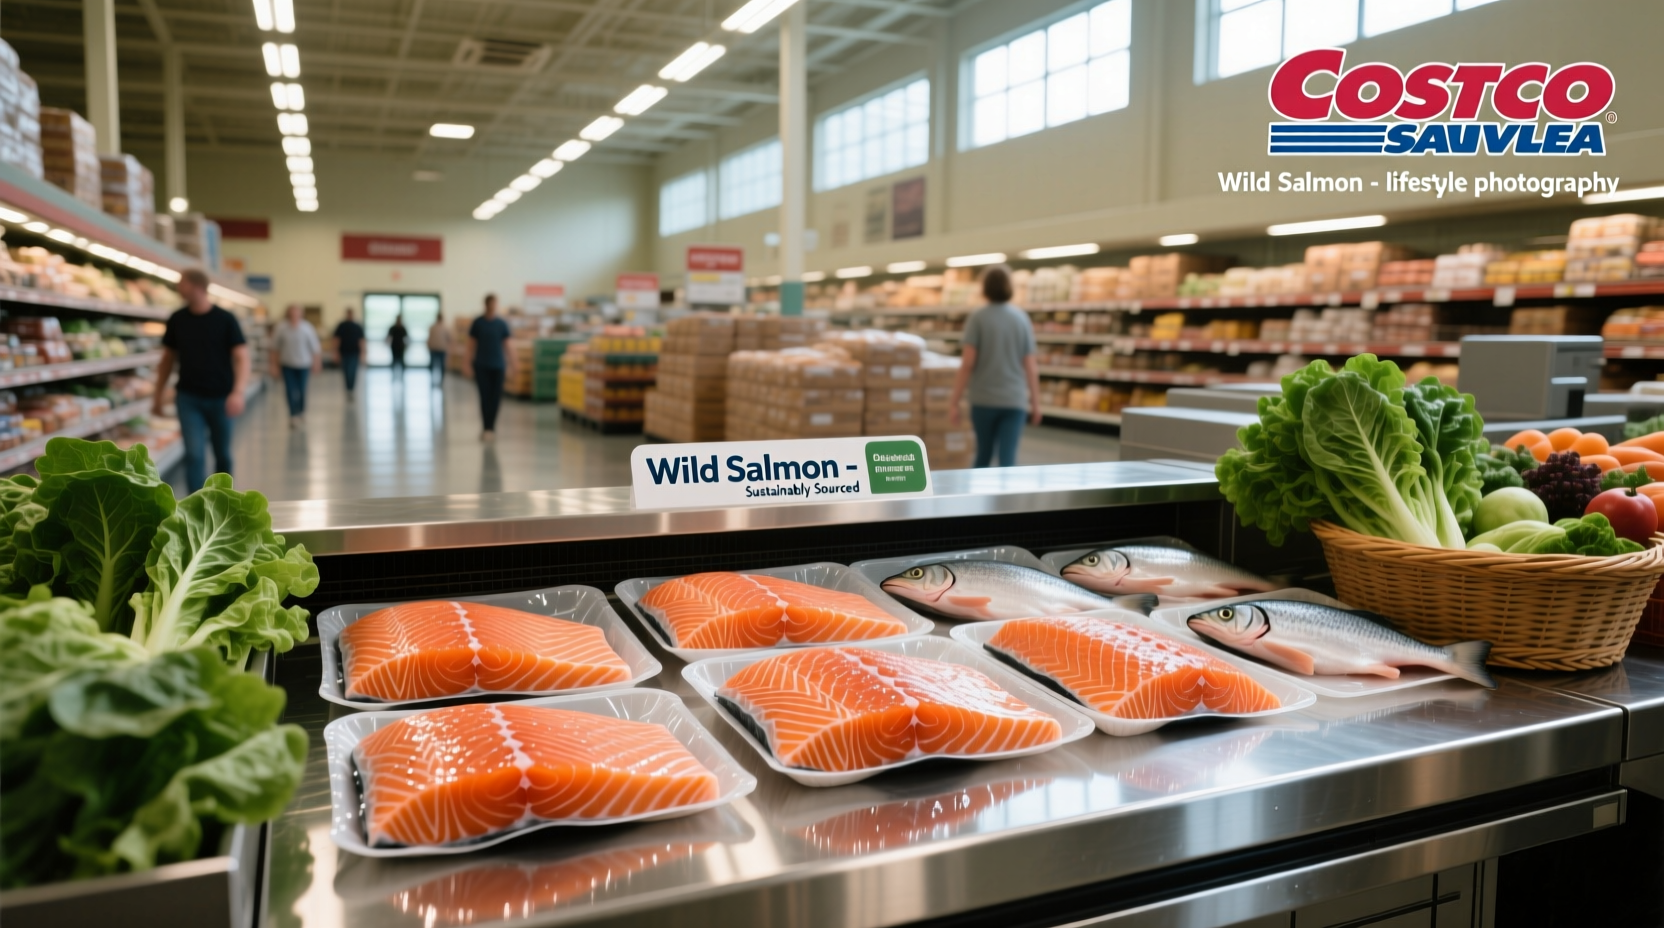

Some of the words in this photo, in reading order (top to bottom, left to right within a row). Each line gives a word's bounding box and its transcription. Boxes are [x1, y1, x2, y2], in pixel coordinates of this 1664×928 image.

[645, 454, 720, 485] Wild
[726, 453, 839, 483] Salmon
[745, 483, 811, 499] Sustainably
[814, 480, 860, 495] Sourced
